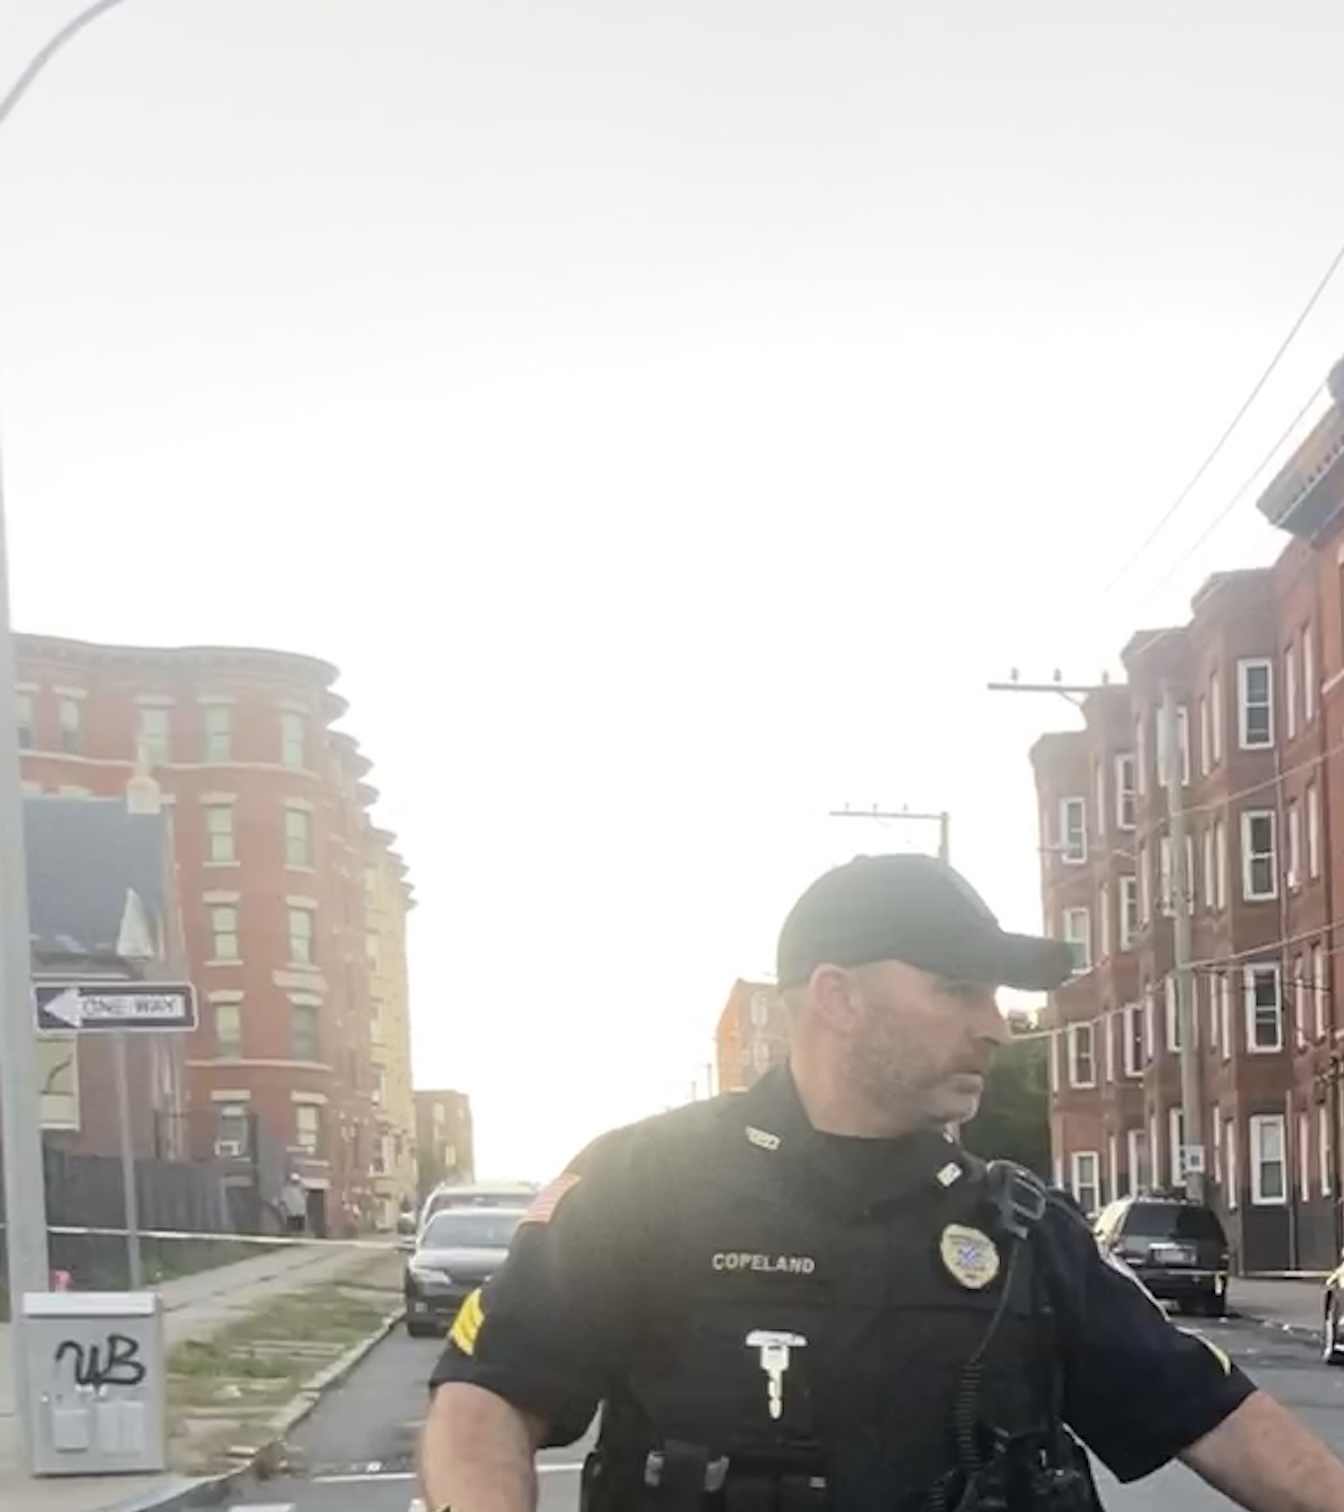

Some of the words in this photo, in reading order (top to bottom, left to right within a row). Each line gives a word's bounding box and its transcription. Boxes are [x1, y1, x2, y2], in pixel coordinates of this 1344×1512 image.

[83, 997, 127, 1015] ONE
[134, 997, 175, 1014] WAY
[711, 1252, 816, 1275] COPELAND
